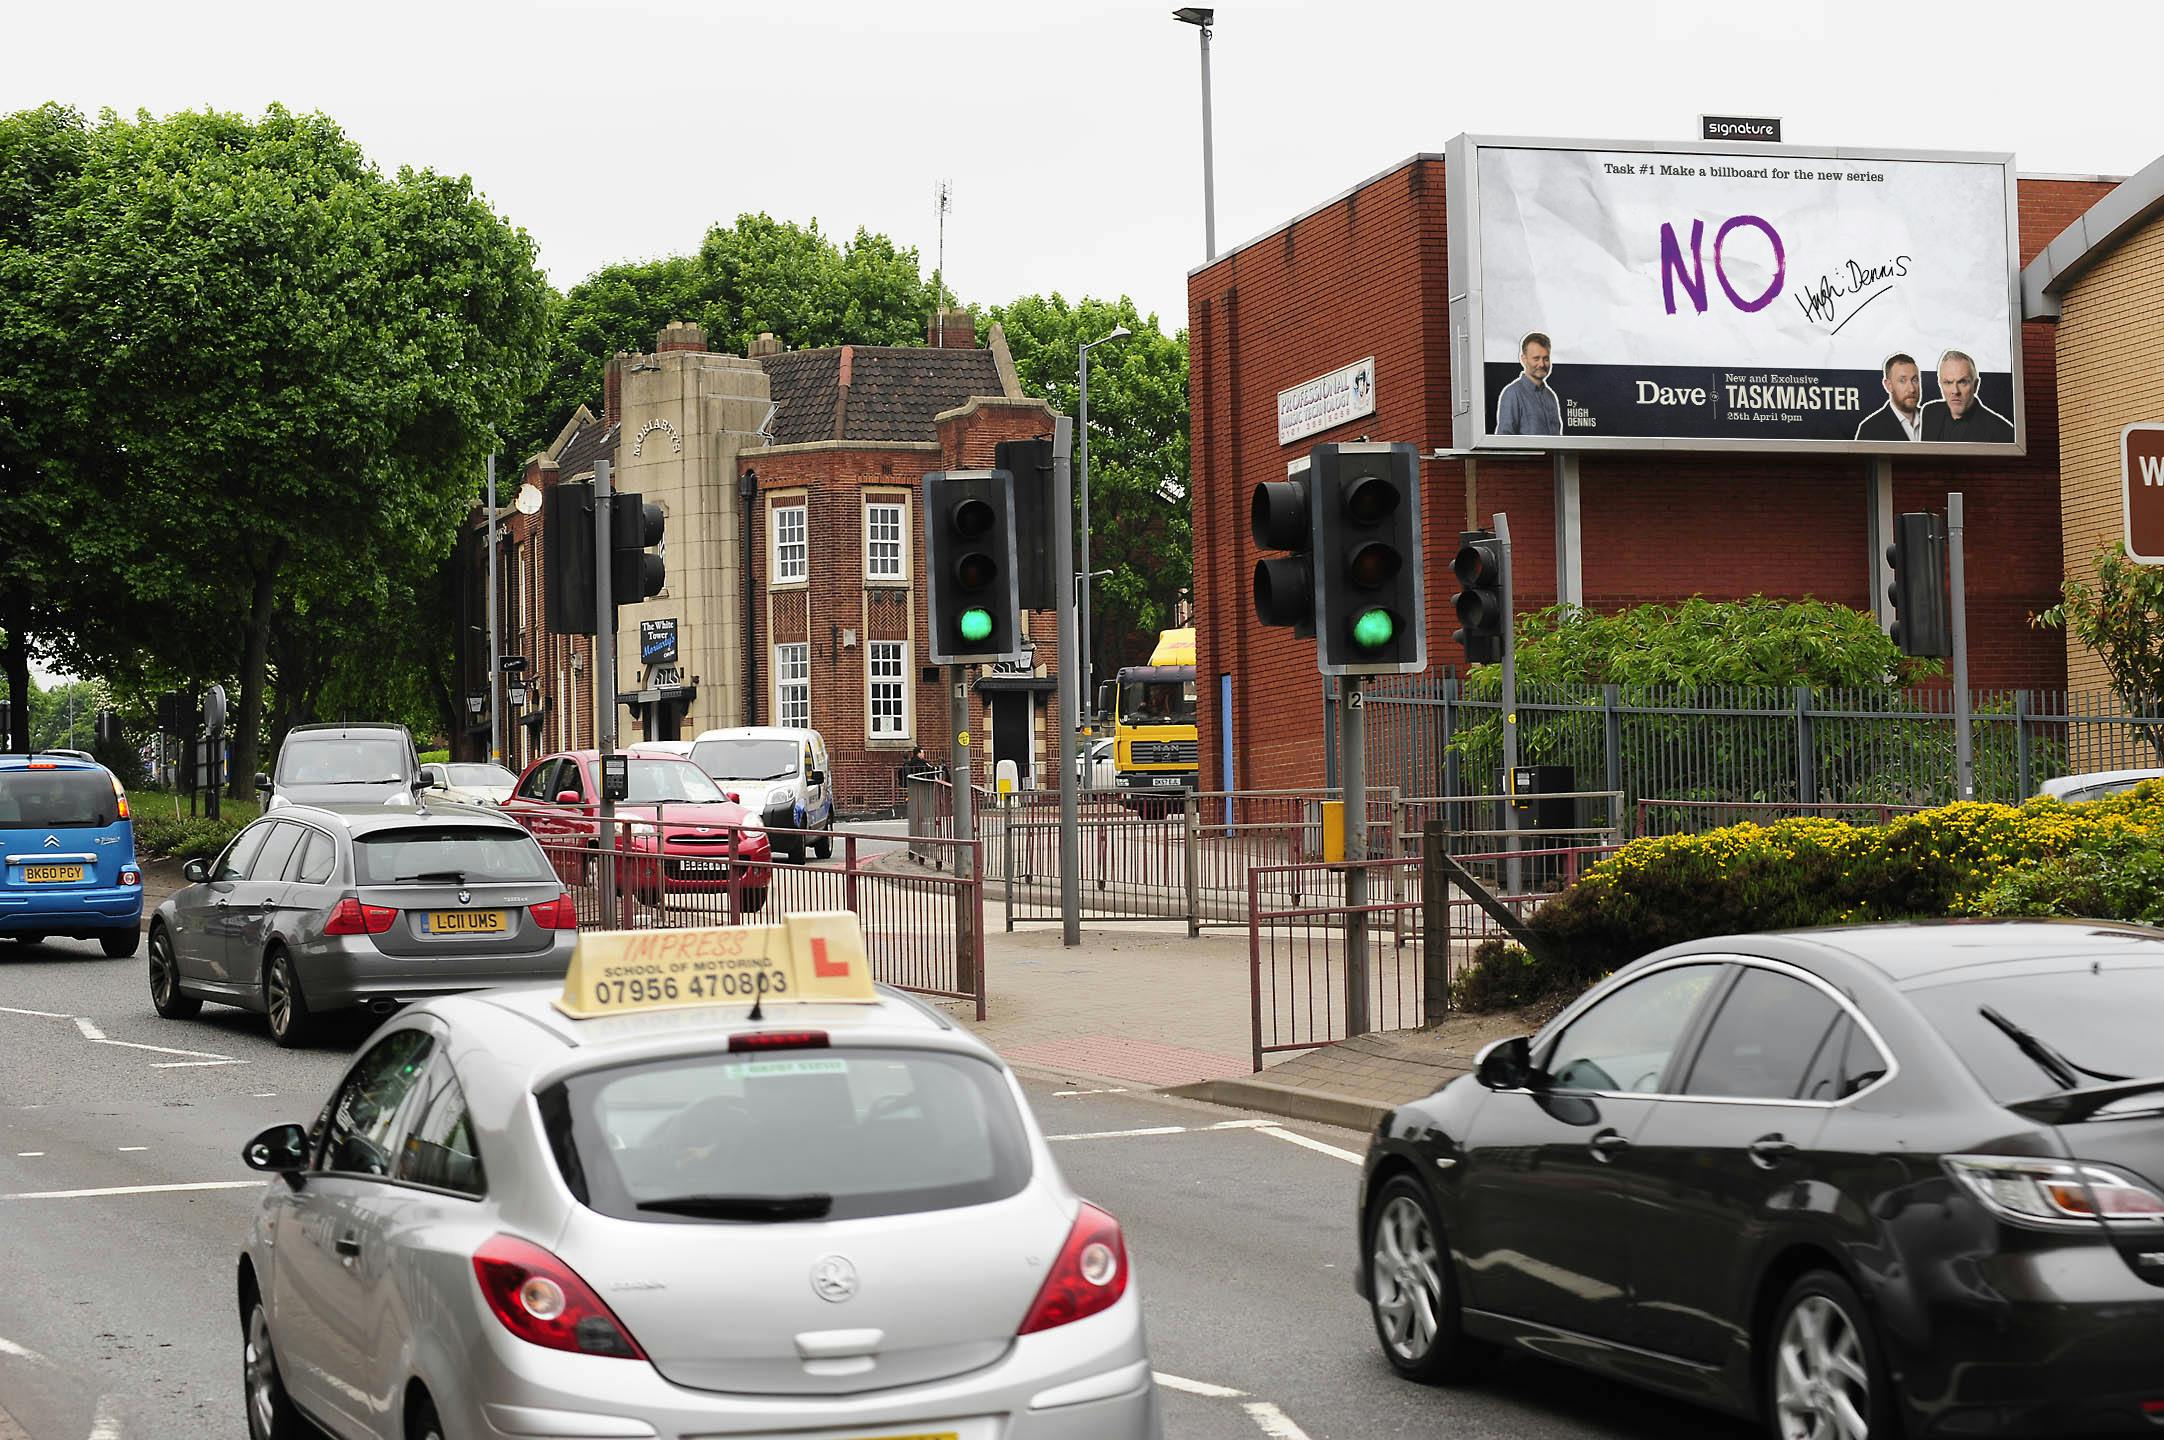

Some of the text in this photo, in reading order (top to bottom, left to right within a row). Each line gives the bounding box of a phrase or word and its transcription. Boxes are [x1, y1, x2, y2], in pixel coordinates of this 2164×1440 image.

[1709, 122, 1774, 136] signature
[1603, 163, 1885, 183] Task #1 Make a billboard for the new series
[1660, 215, 1786, 315] NO
[1845, 255, 1912, 293] Dennis
[1725, 373, 1819, 385] New and Exclusive
[1280, 373, 1350, 415] PROFESSIONAL
[1635, 380, 1707, 406] Dave
[1725, 385, 1860, 411] TASKMASTER
[1304, 392, 1350, 422] TECHNOLOGY
[1566, 398, 1578, 408] By
[1567, 408, 1589, 418] HUGH
[1727, 412, 1803, 422] 25th April 9pm
[1567, 417, 1597, 428] DENNIS
[641, 620, 674, 631] The White
[647, 631, 669, 640] Tower
[957, 684, 964, 697] 1
[1351, 692, 1362, 708] 2
[26, 867, 81, 879] BK60 PGY
[436, 913, 498, 929] LC11 UMS
[622, 929, 750, 962] IMPRESS
[810, 937, 849, 978] L
[604, 957, 773, 978] SCHOOL OF MOTORING
[595, 970, 787, 1005] 07956 470803
